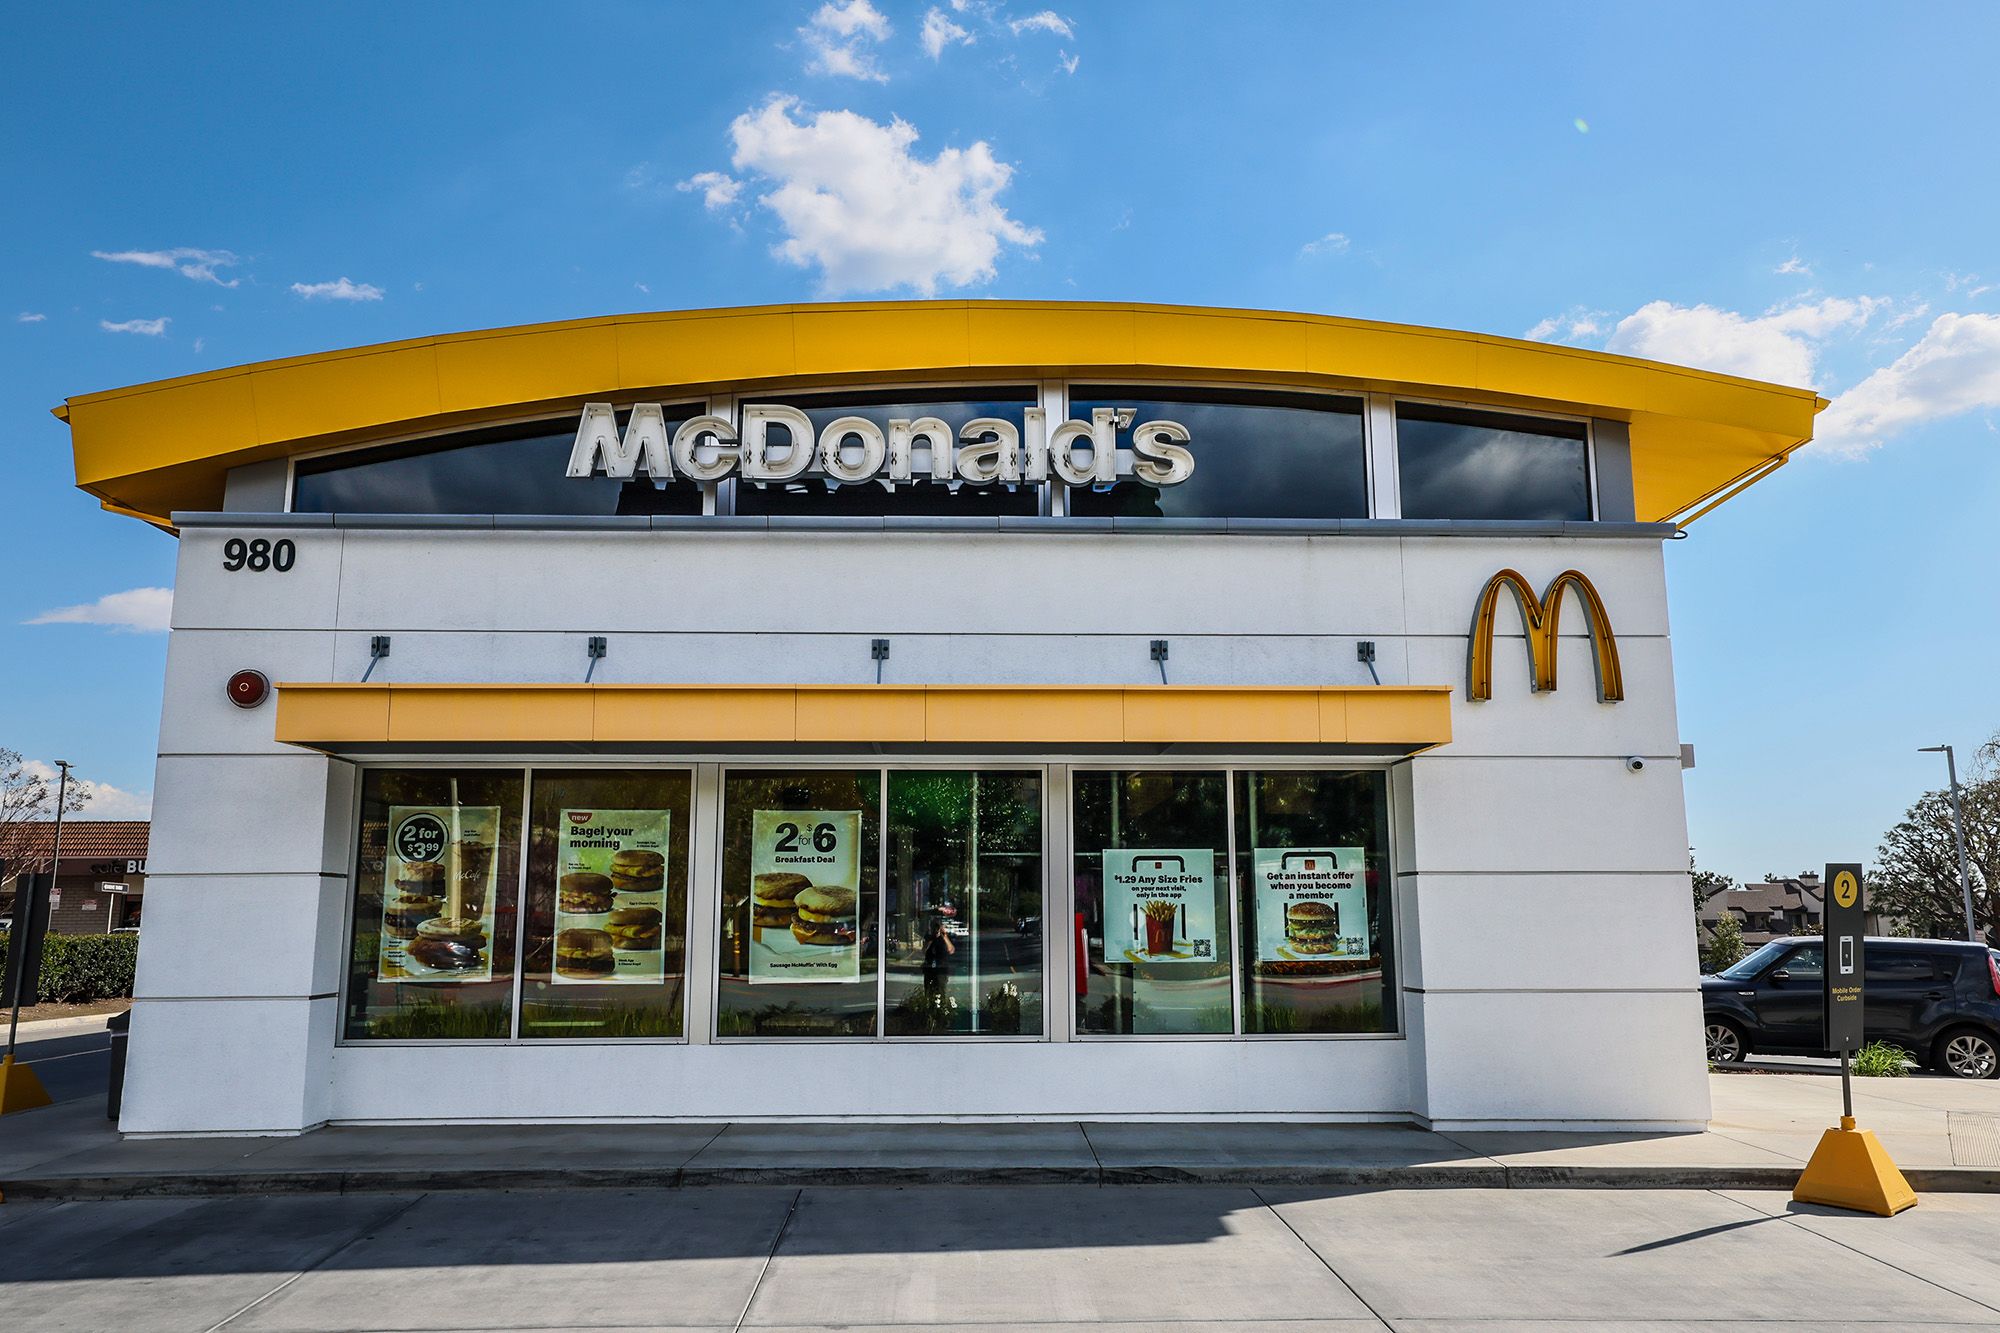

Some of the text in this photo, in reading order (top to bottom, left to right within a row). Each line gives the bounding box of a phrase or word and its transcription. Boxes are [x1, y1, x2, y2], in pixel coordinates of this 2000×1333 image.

[566, 402, 1195, 488] McDonald's
[223, 538, 296, 572] 980
[403, 825, 439, 842] 2 for
[570, 825, 634, 838] Bagel your
[775, 822, 799, 852] 2
[798, 834, 812, 846] for
[569, 838, 621, 850] morning
[775, 855, 836, 863] Breakfast Deal
[1114, 875, 1203, 885] $1.29 Any Size Fries
[1266, 872, 1284, 880] Get
[1297, 871, 1331, 880] instant
[1332, 871, 1355, 880] offer
[1170, 884, 1187, 892] visit,
[1270, 881, 1352, 891] when you become
[1841, 880, 1850, 898] 2
[1136, 891, 1151, 900] only
[1295, 891, 1334, 899] member
[1836, 994, 1857, 1002] Curbside
